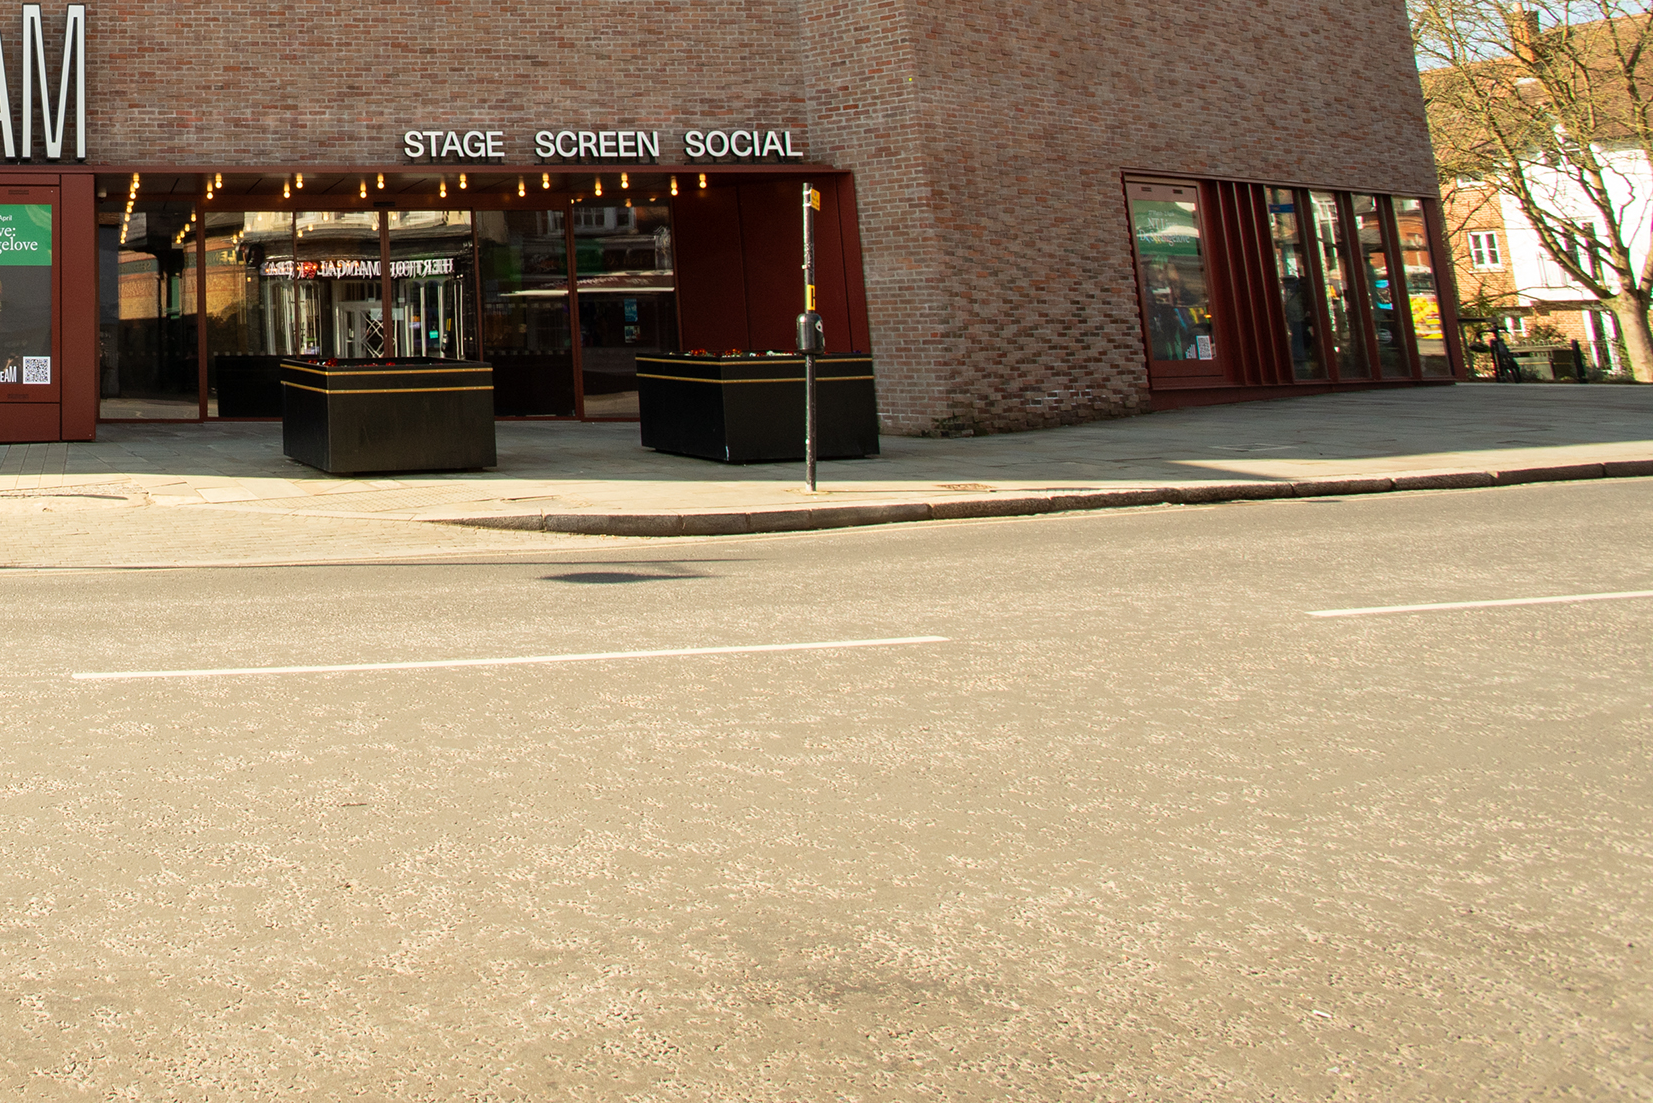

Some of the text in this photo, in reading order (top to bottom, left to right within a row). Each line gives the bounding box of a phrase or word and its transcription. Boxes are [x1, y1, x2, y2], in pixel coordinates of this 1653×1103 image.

[403, 130, 804, 158] STAGE SCREEN SOCIAL
